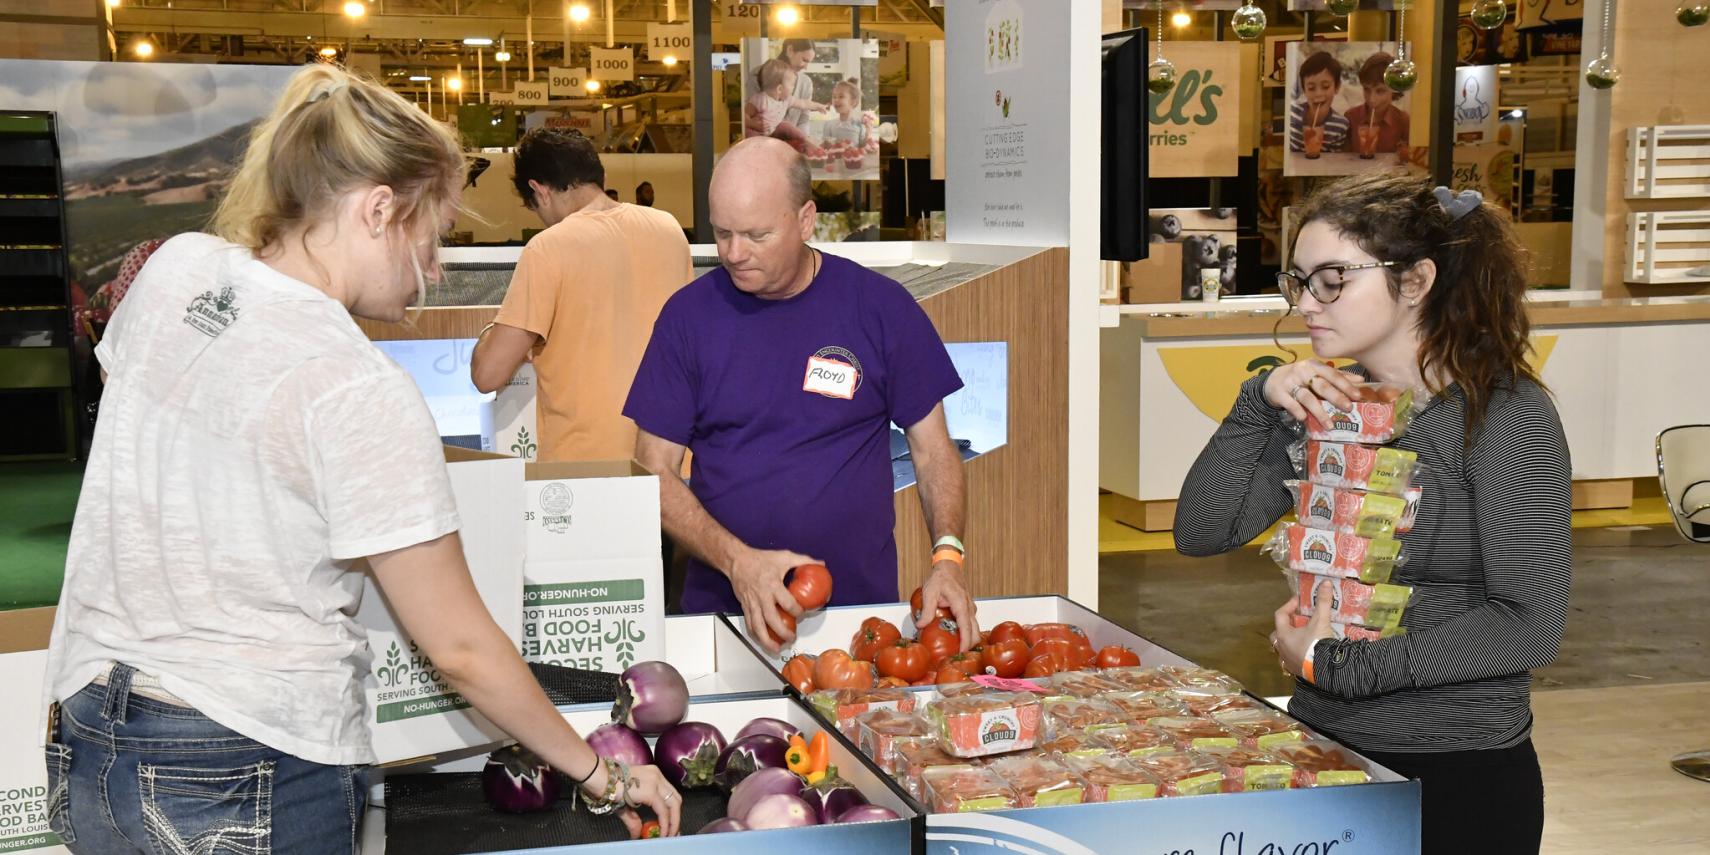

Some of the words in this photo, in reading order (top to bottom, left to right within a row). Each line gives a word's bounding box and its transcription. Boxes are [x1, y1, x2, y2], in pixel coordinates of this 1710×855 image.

[727, 4, 760, 18] 120
[653, 36, 690, 49] 1100
[595, 59, 629, 71] 1000
[552, 77, 579, 87] 900
[517, 90, 542, 100] 800
[1149, 130, 1188, 146] rries
[1454, 163, 1482, 183] esh
[808, 367, 846, 384] FLOYD
[1303, 549, 1332, 563] CLOUD9
[523, 587, 608, 601] NO-HUNGER.O
[549, 607, 589, 618] SOUTH
[593, 603, 645, 616] SERVING
[543, 619, 602, 636] FOOD
[410, 670, 441, 685] FOO
[377, 688, 416, 702] SERVING
[418, 683, 449, 694] SOUTH
[403, 697, 467, 713] NO-HUNGER.OR
[983, 730, 1016, 744] CLOUD9
[0, 786, 46, 802] COND
[0, 799, 48, 816] RVES
[0, 816, 22, 828] OD
[27, 812, 47, 824] BA
[0, 828, 19, 836] UTH
[22, 824, 48, 834] LOUIS
[0, 836, 46, 849] NGER.ORG
